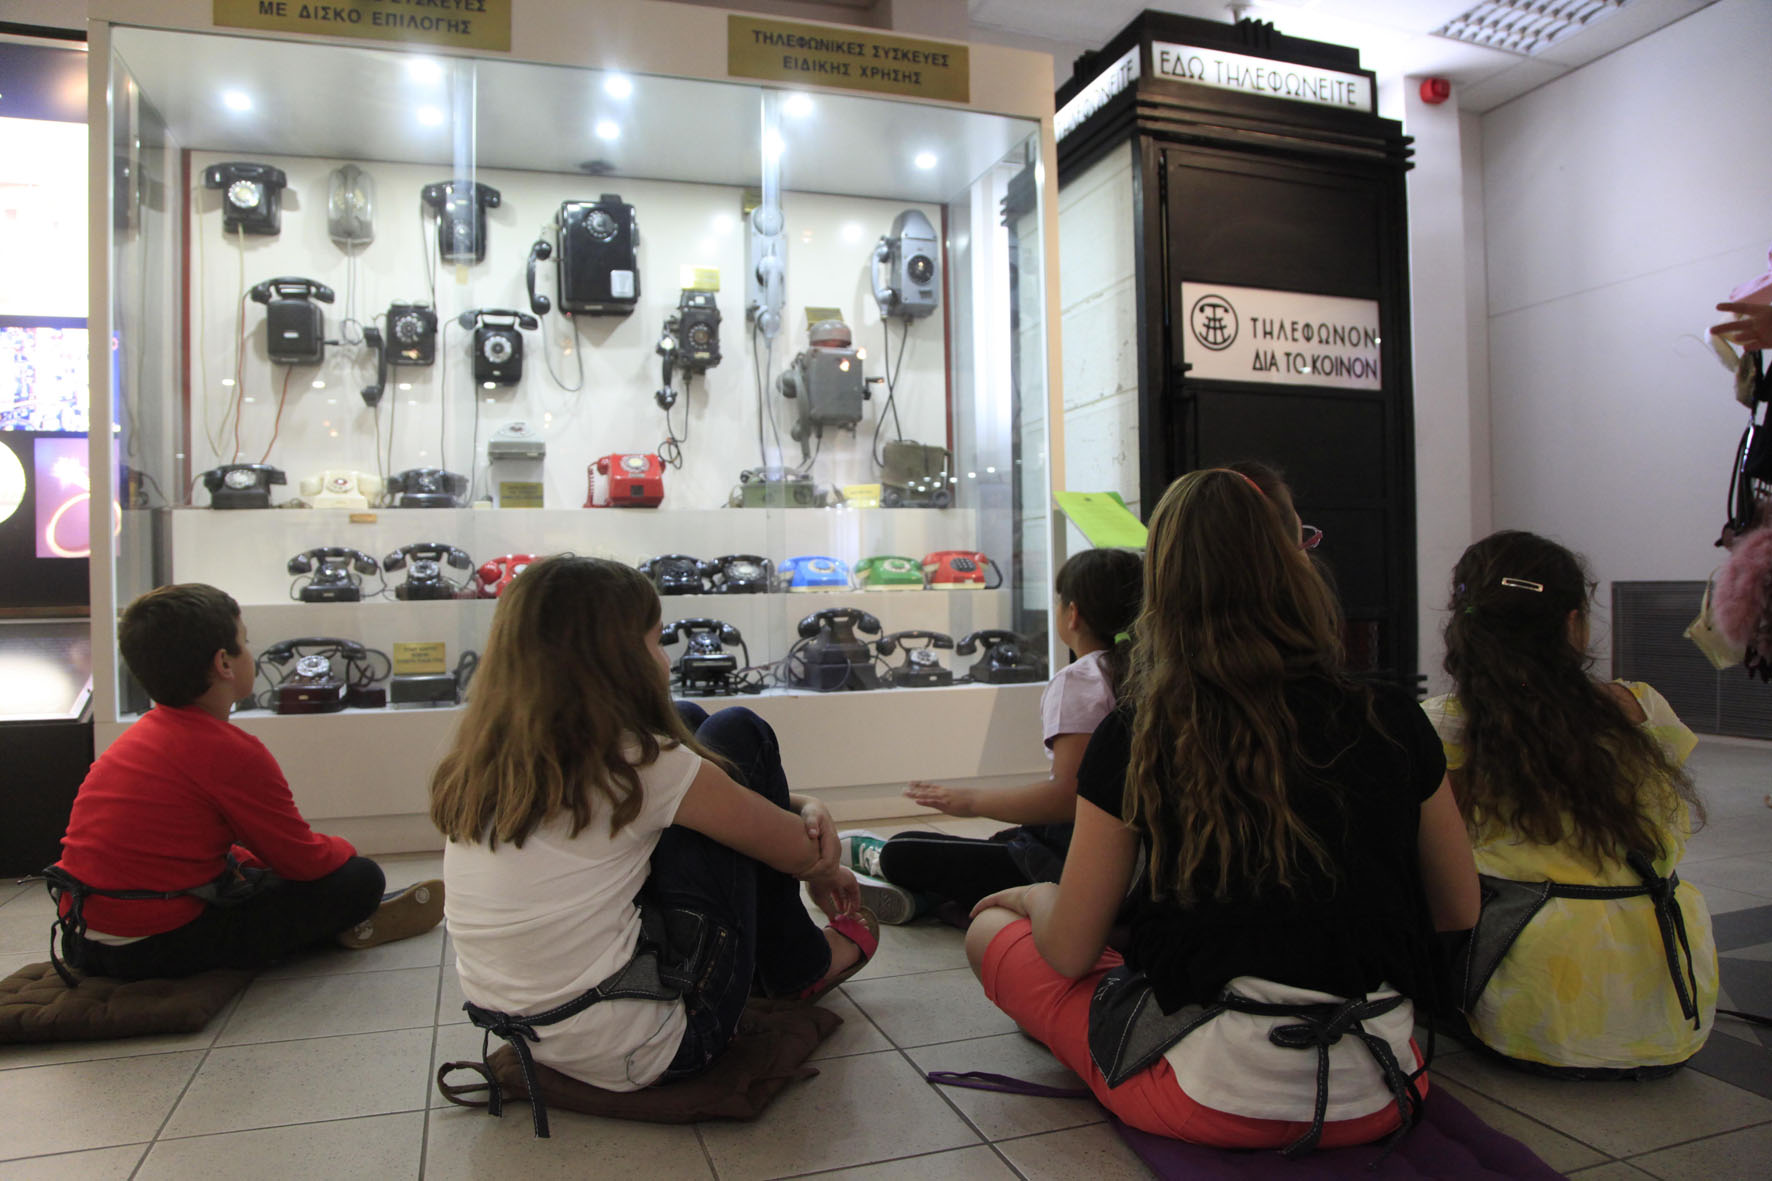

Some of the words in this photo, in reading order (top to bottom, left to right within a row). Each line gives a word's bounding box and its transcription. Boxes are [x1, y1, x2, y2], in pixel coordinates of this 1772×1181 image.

[258, 0, 288, 17] ΜΕ
[298, 4, 362, 24] ΔΙΣΚΟ
[371, 11, 473, 35] ΕΠΙΛΟΓΗΣ
[752, 29, 866, 57] ΤΗΛΕΦΩΝΙΚΕΣ
[872, 45, 949, 68] ΣΥΣΚΕΥΕΣ
[783, 55, 851, 77] ΕΙΔΙΚΗΣ
[859, 65, 922, 85] ΧΡΗΣΗΣ
[1160, 50, 1205, 81] ΕΔΩ
[1213, 60, 1357, 106] ΤΗΛΕΦΩΝΕΙΤΕ
[1250, 317, 1377, 349] ΤΗΛΕΦΩΝΟΝ
[1252, 349, 1280, 373] ΔΙΑ
[1311, 354, 1378, 381] ΚΟΙΝΟΝ
